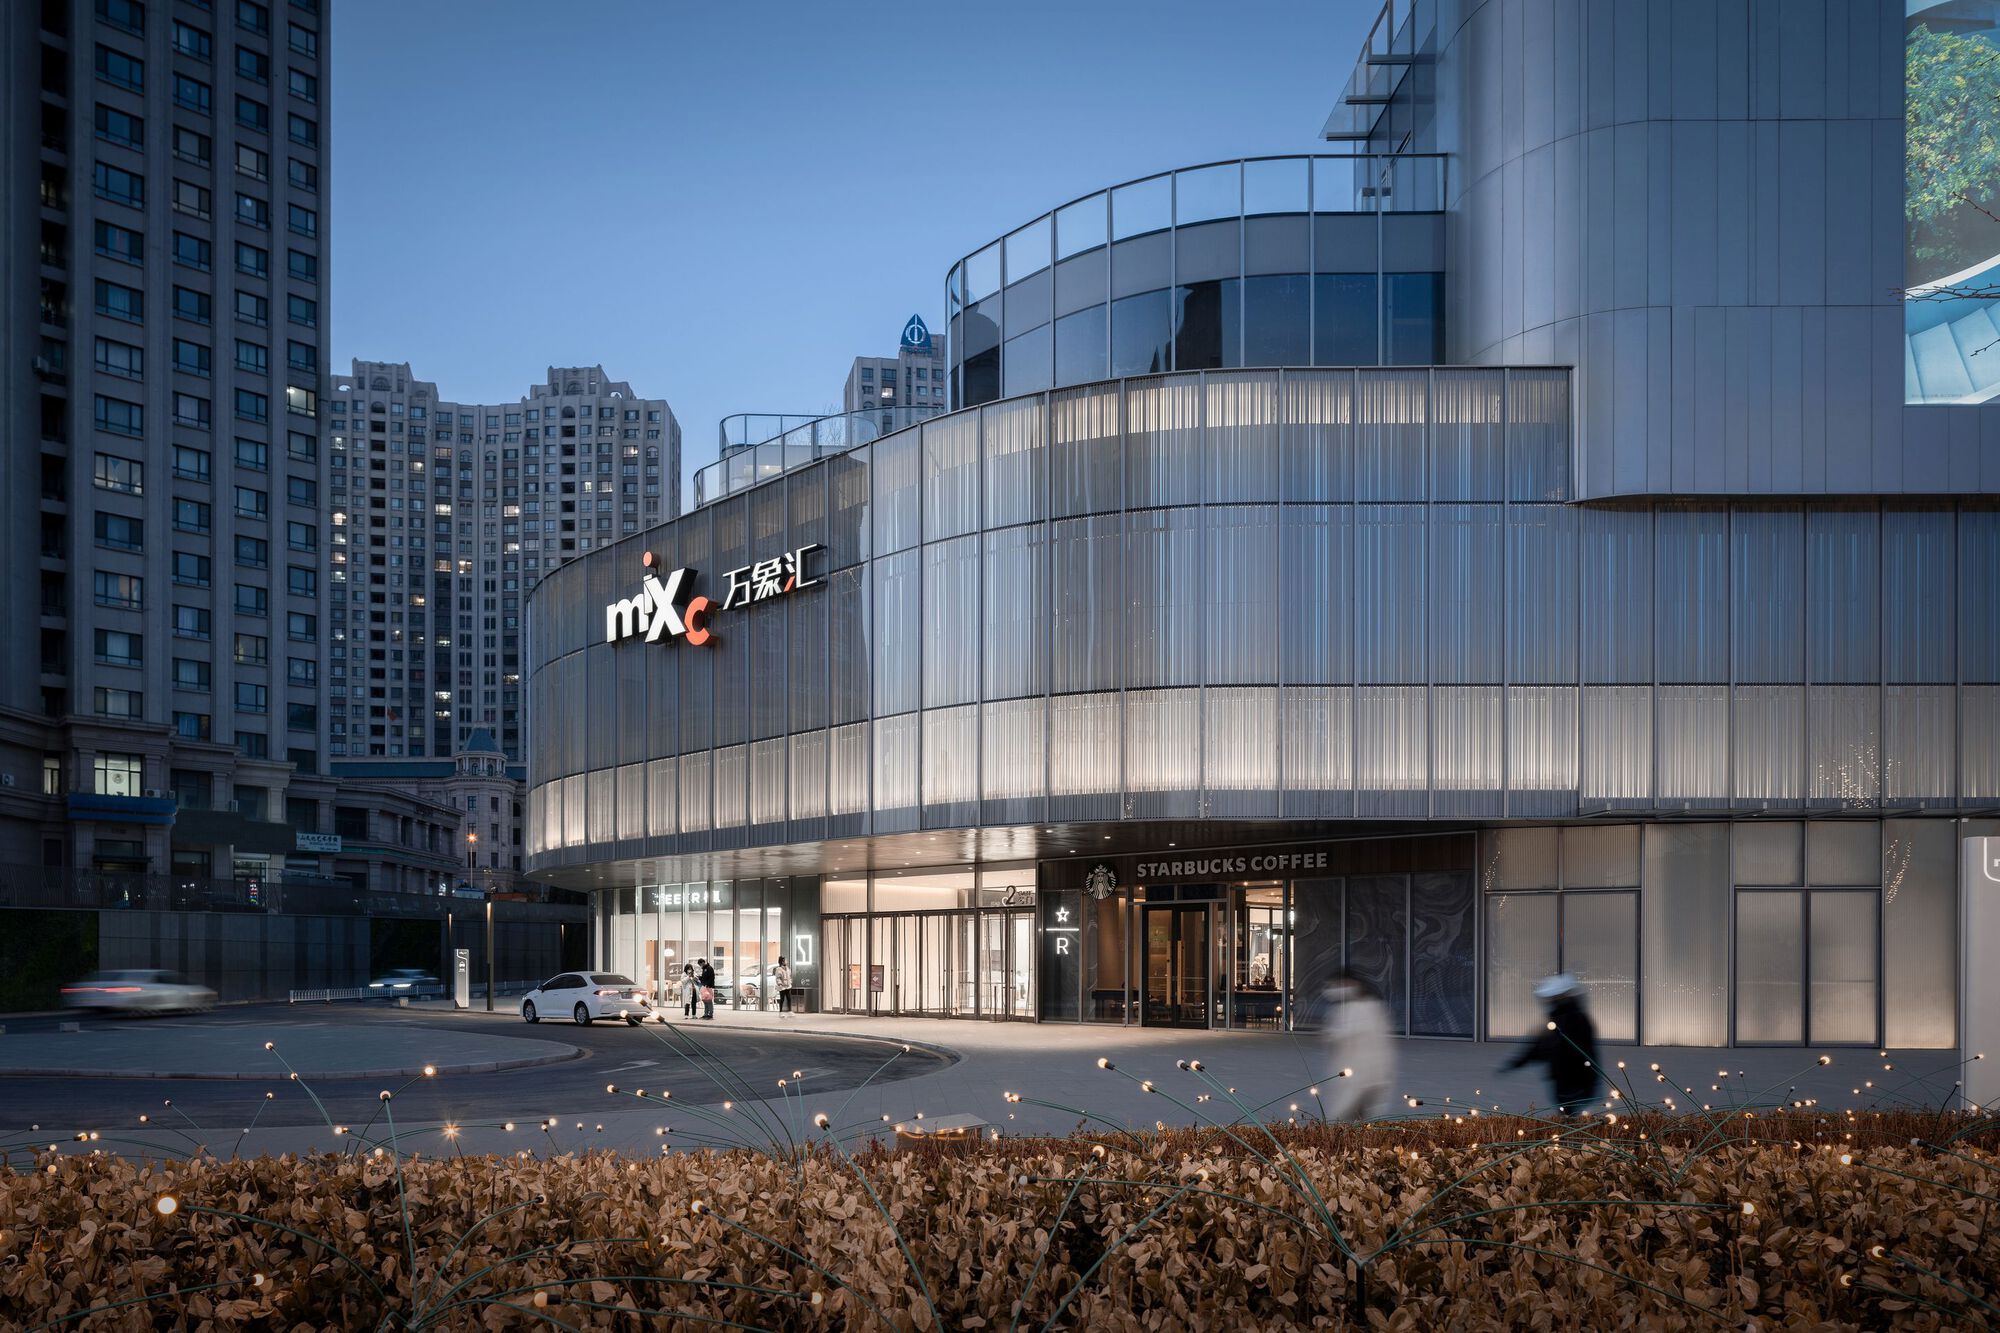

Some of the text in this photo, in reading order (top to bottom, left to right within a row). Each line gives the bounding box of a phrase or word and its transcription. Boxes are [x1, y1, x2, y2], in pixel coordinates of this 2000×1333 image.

[722, 543, 824, 611] 万象汇
[1137, 852, 1328, 877] STARBUCKS COFFEE
[1005, 885, 1017, 905] 2
[1056, 937, 1069, 955] R
